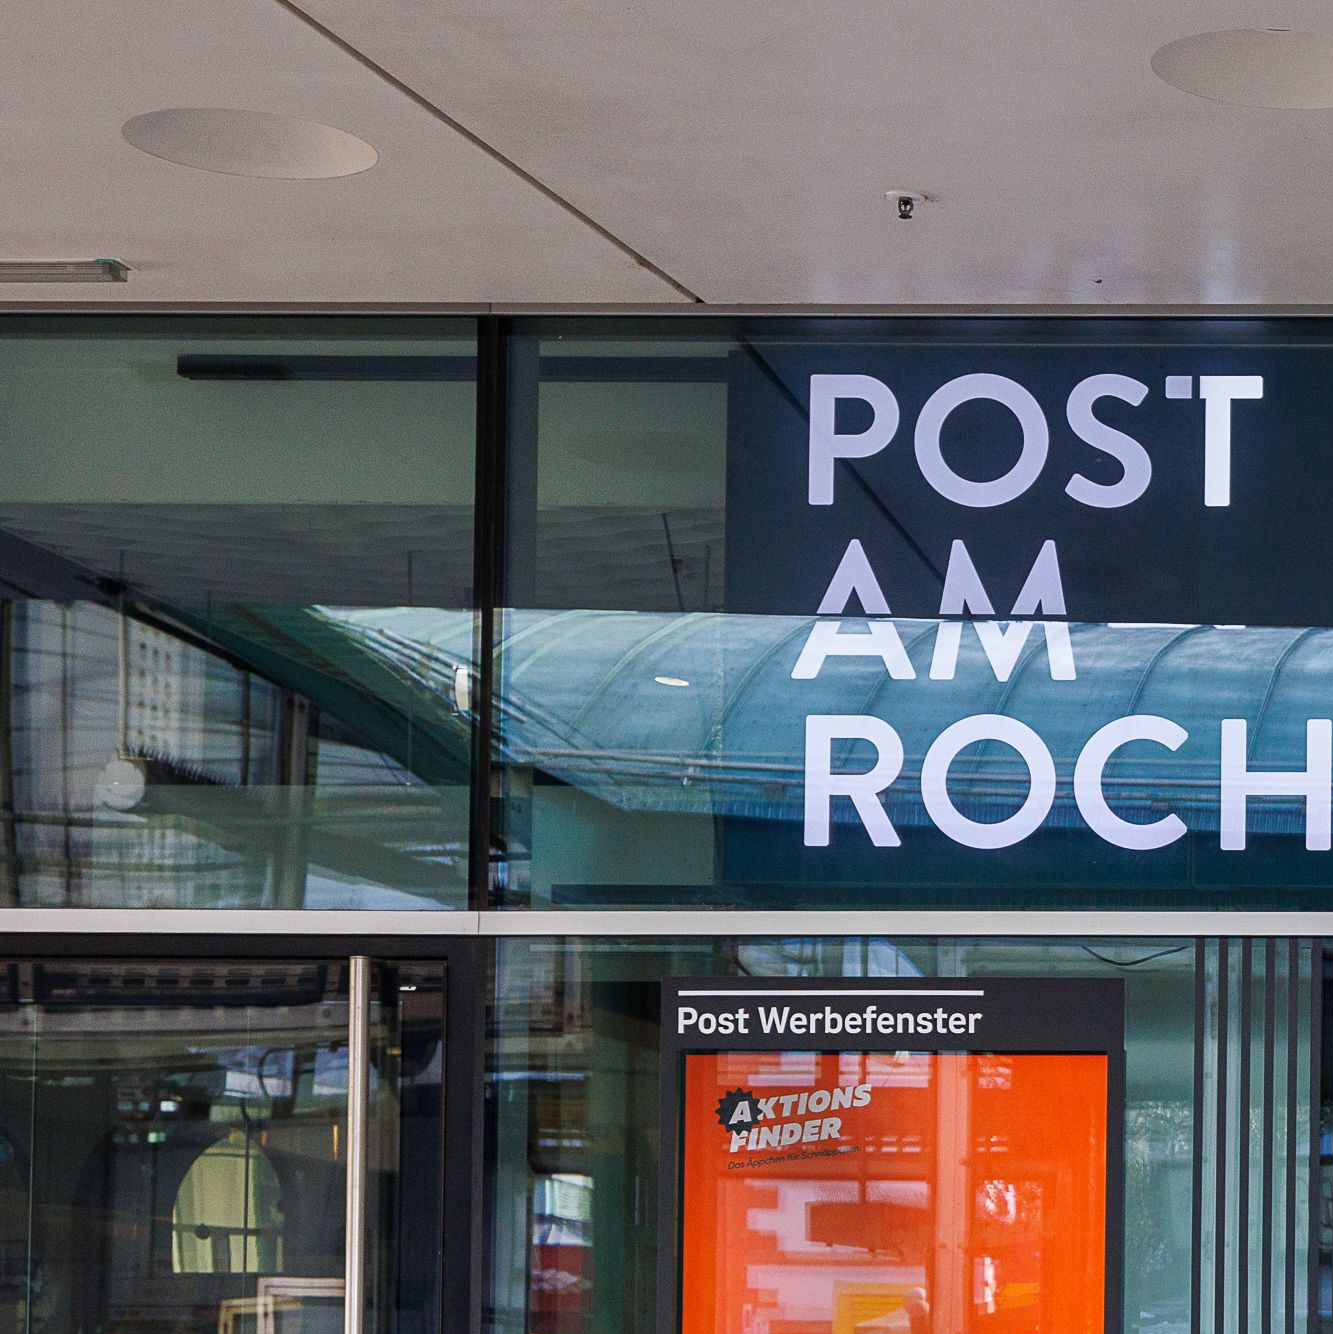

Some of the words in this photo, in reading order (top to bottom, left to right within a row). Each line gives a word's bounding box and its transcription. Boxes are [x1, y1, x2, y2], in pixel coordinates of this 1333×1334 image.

[808, 373, 1263, 508] POST
[791, 539, 1077, 682] AM
[677, 1006, 749, 1035] Post
[758, 1005, 982, 1035] Werbefenster
[729, 1083, 872, 1124] AKTIONS
[729, 1117, 842, 1153] FINDER
